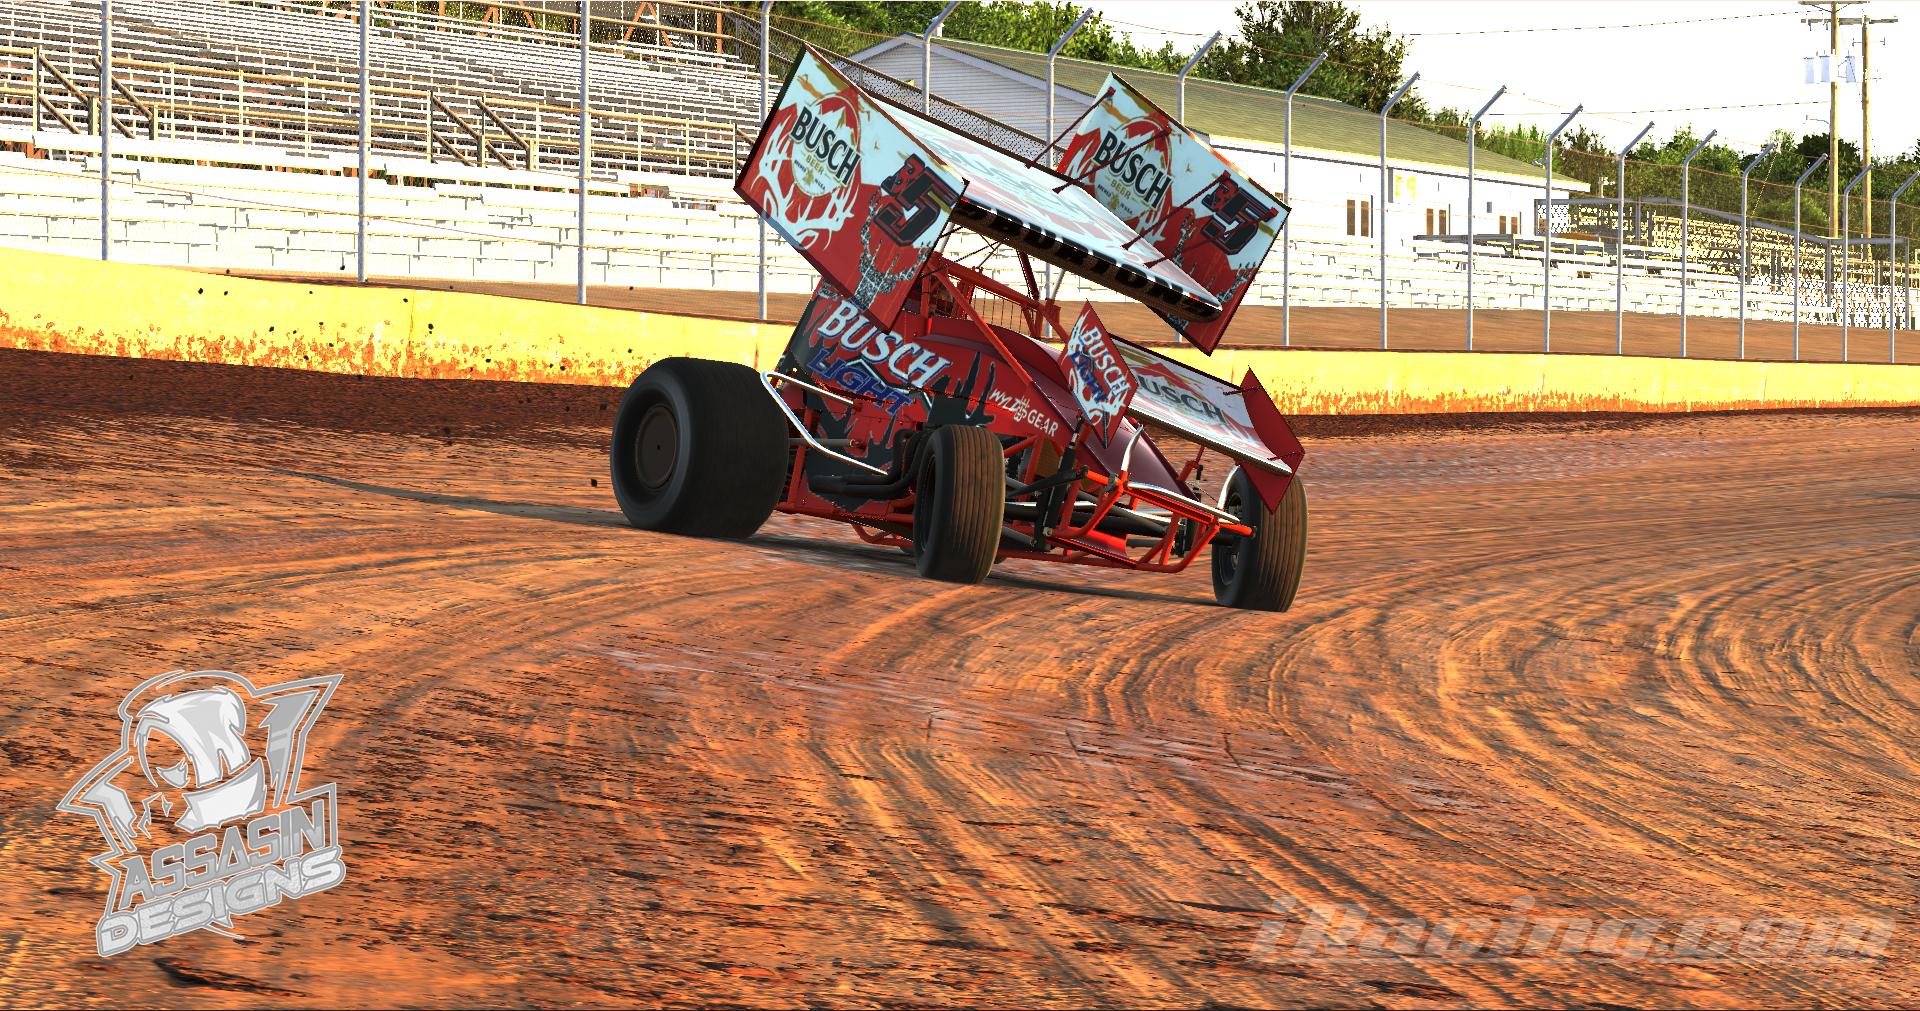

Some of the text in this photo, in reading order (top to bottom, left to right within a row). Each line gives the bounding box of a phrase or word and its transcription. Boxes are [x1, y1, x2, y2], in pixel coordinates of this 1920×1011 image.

[790, 106, 861, 185] BUSCH
[1093, 130, 1173, 209] BUSCH
[817, 300, 953, 389] BUSCH
[1080, 326, 1132, 397] BUSCH
[806, 348, 913, 417] LIGHT
[1137, 375, 1227, 425] USCH
[1027, 409, 1059, 437] GEAR
